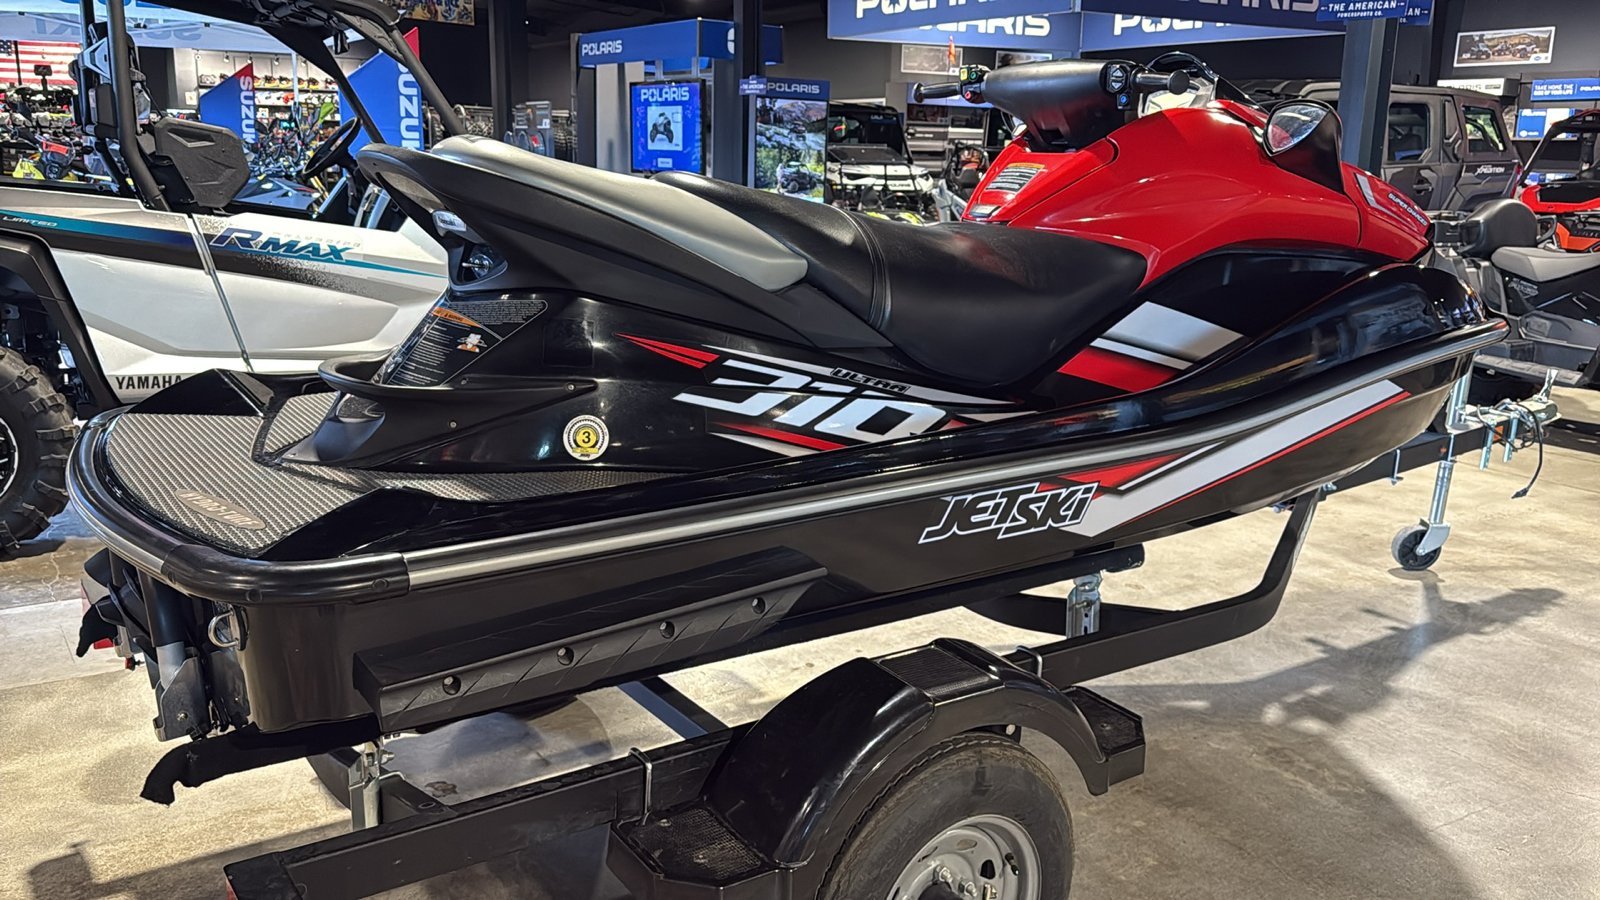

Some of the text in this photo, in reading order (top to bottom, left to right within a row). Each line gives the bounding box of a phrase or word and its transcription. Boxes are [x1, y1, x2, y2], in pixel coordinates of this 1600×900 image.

[1328, 3, 1346, 12] THE
[1348, 0, 1397, 10] AMERICAN
[582, 40, 622, 56] POLARIS
[641, 87, 689, 102] POLARIS
[767, 82, 820, 94] POLARIS
[240, 75, 255, 151] SUZUK
[398, 63, 420, 149] UZUK
[3, 216, 57, 227] LIMITED
[832, 368, 909, 394] ULTRA
[672, 359, 947, 443] 310
[582, 431, 591, 444] 3
